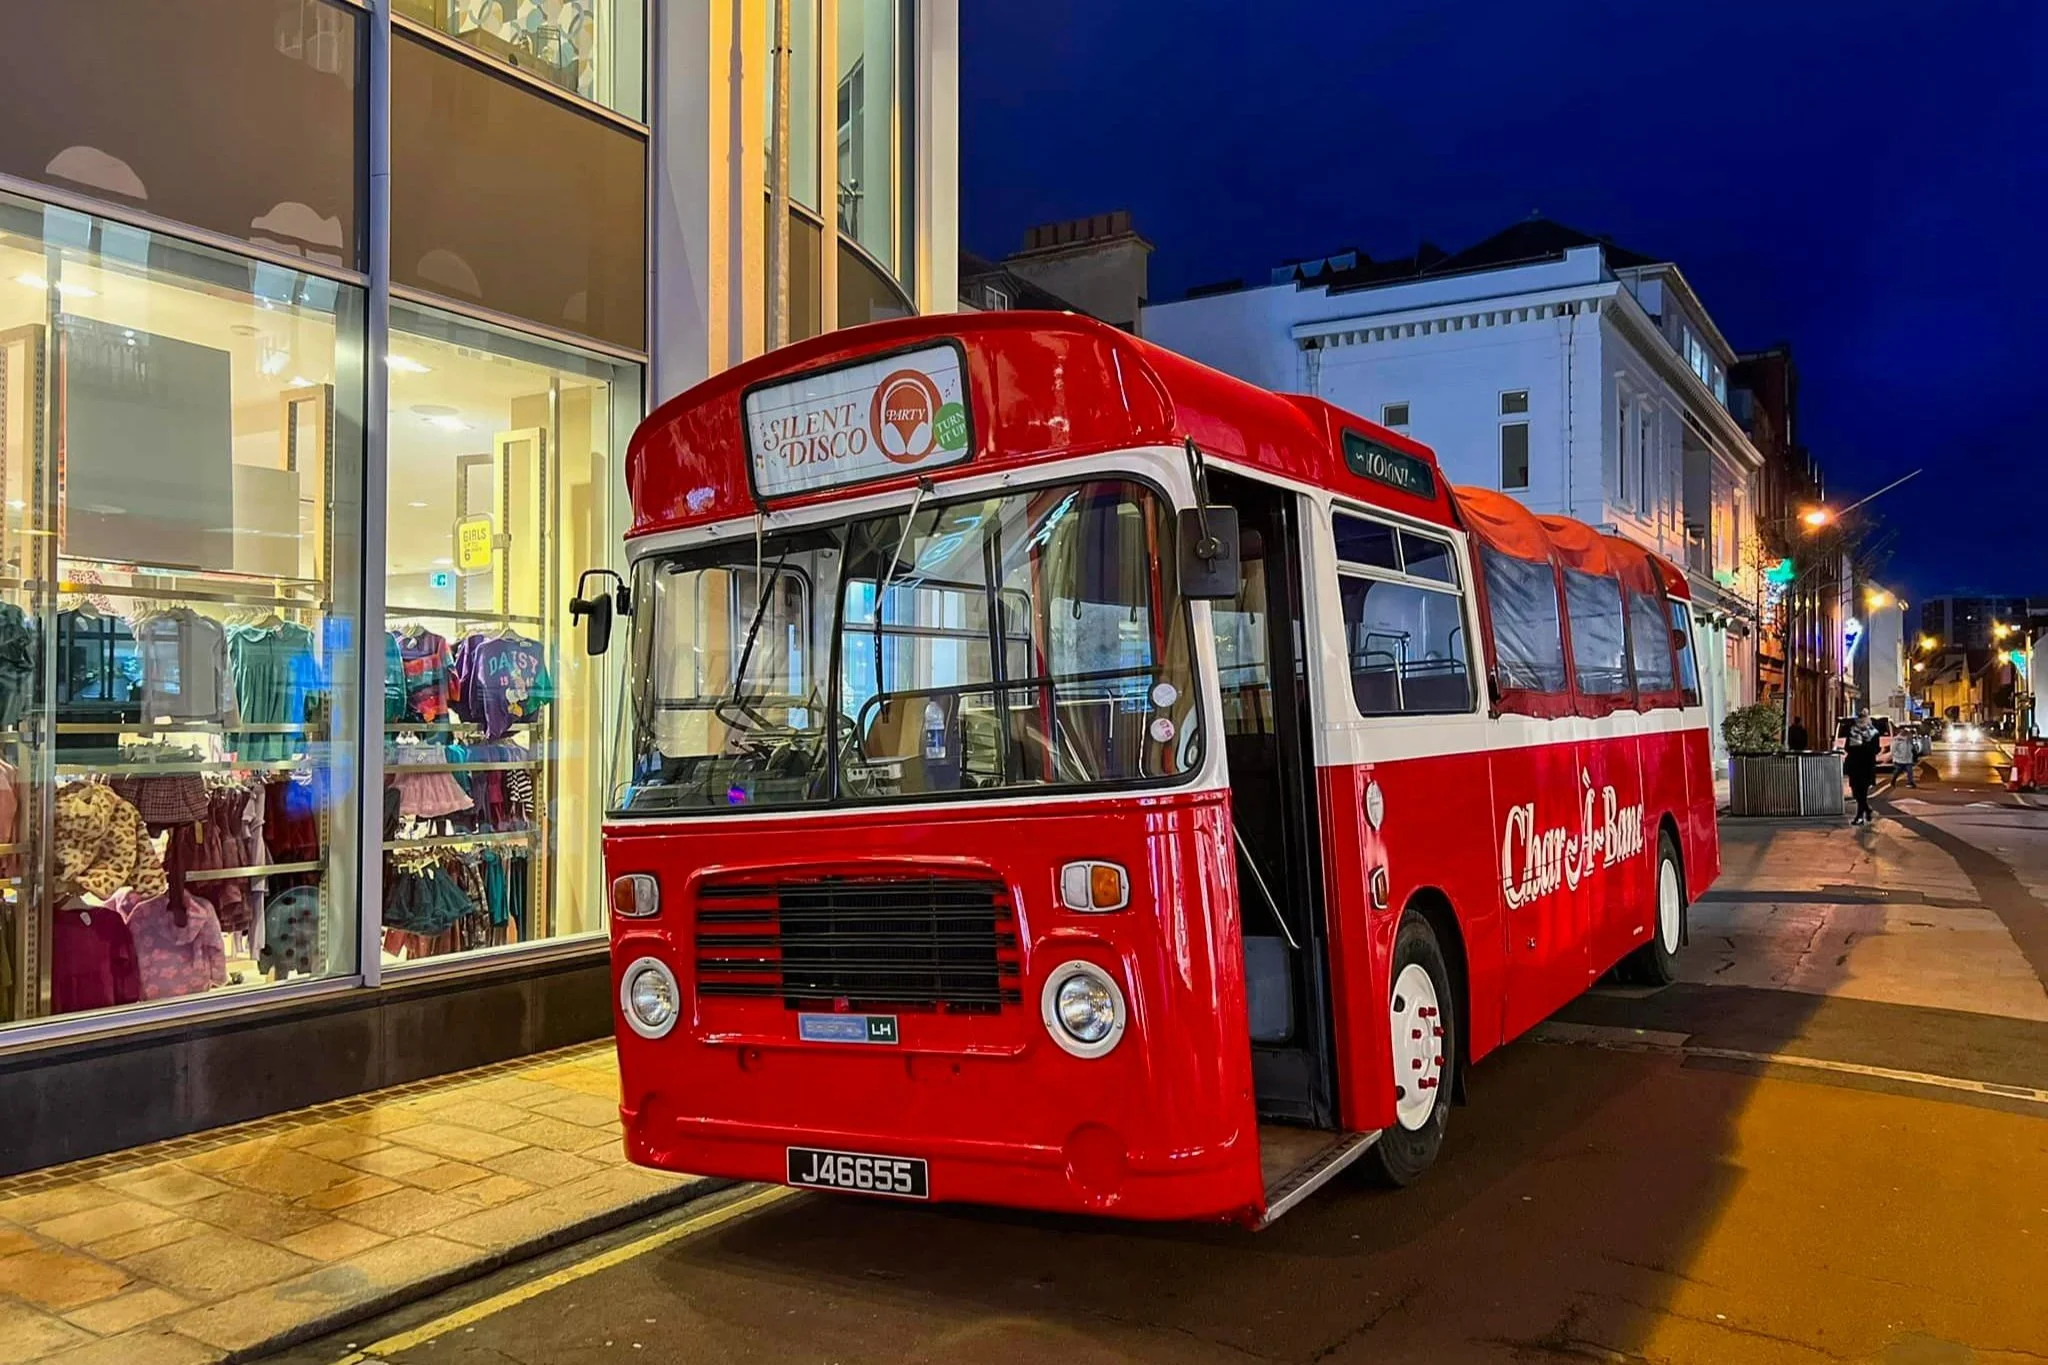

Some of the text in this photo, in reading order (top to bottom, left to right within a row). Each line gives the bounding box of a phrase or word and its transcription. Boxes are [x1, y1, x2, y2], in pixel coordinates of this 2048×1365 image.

[886, 408, 926, 421] PARTY
[936, 412, 964, 433] TURN
[763, 403, 857, 451] SILENT
[940, 430, 951, 445] IT
[779, 427, 868, 469] DISCO
[463, 528, 486, 542] GIRLS
[464, 548, 471, 561] 6
[489, 651, 538, 676] DAISY
[1502, 802, 1566, 910] Char
[871, 1023, 892, 1036] LH
[802, 1153, 912, 1192] J46655
